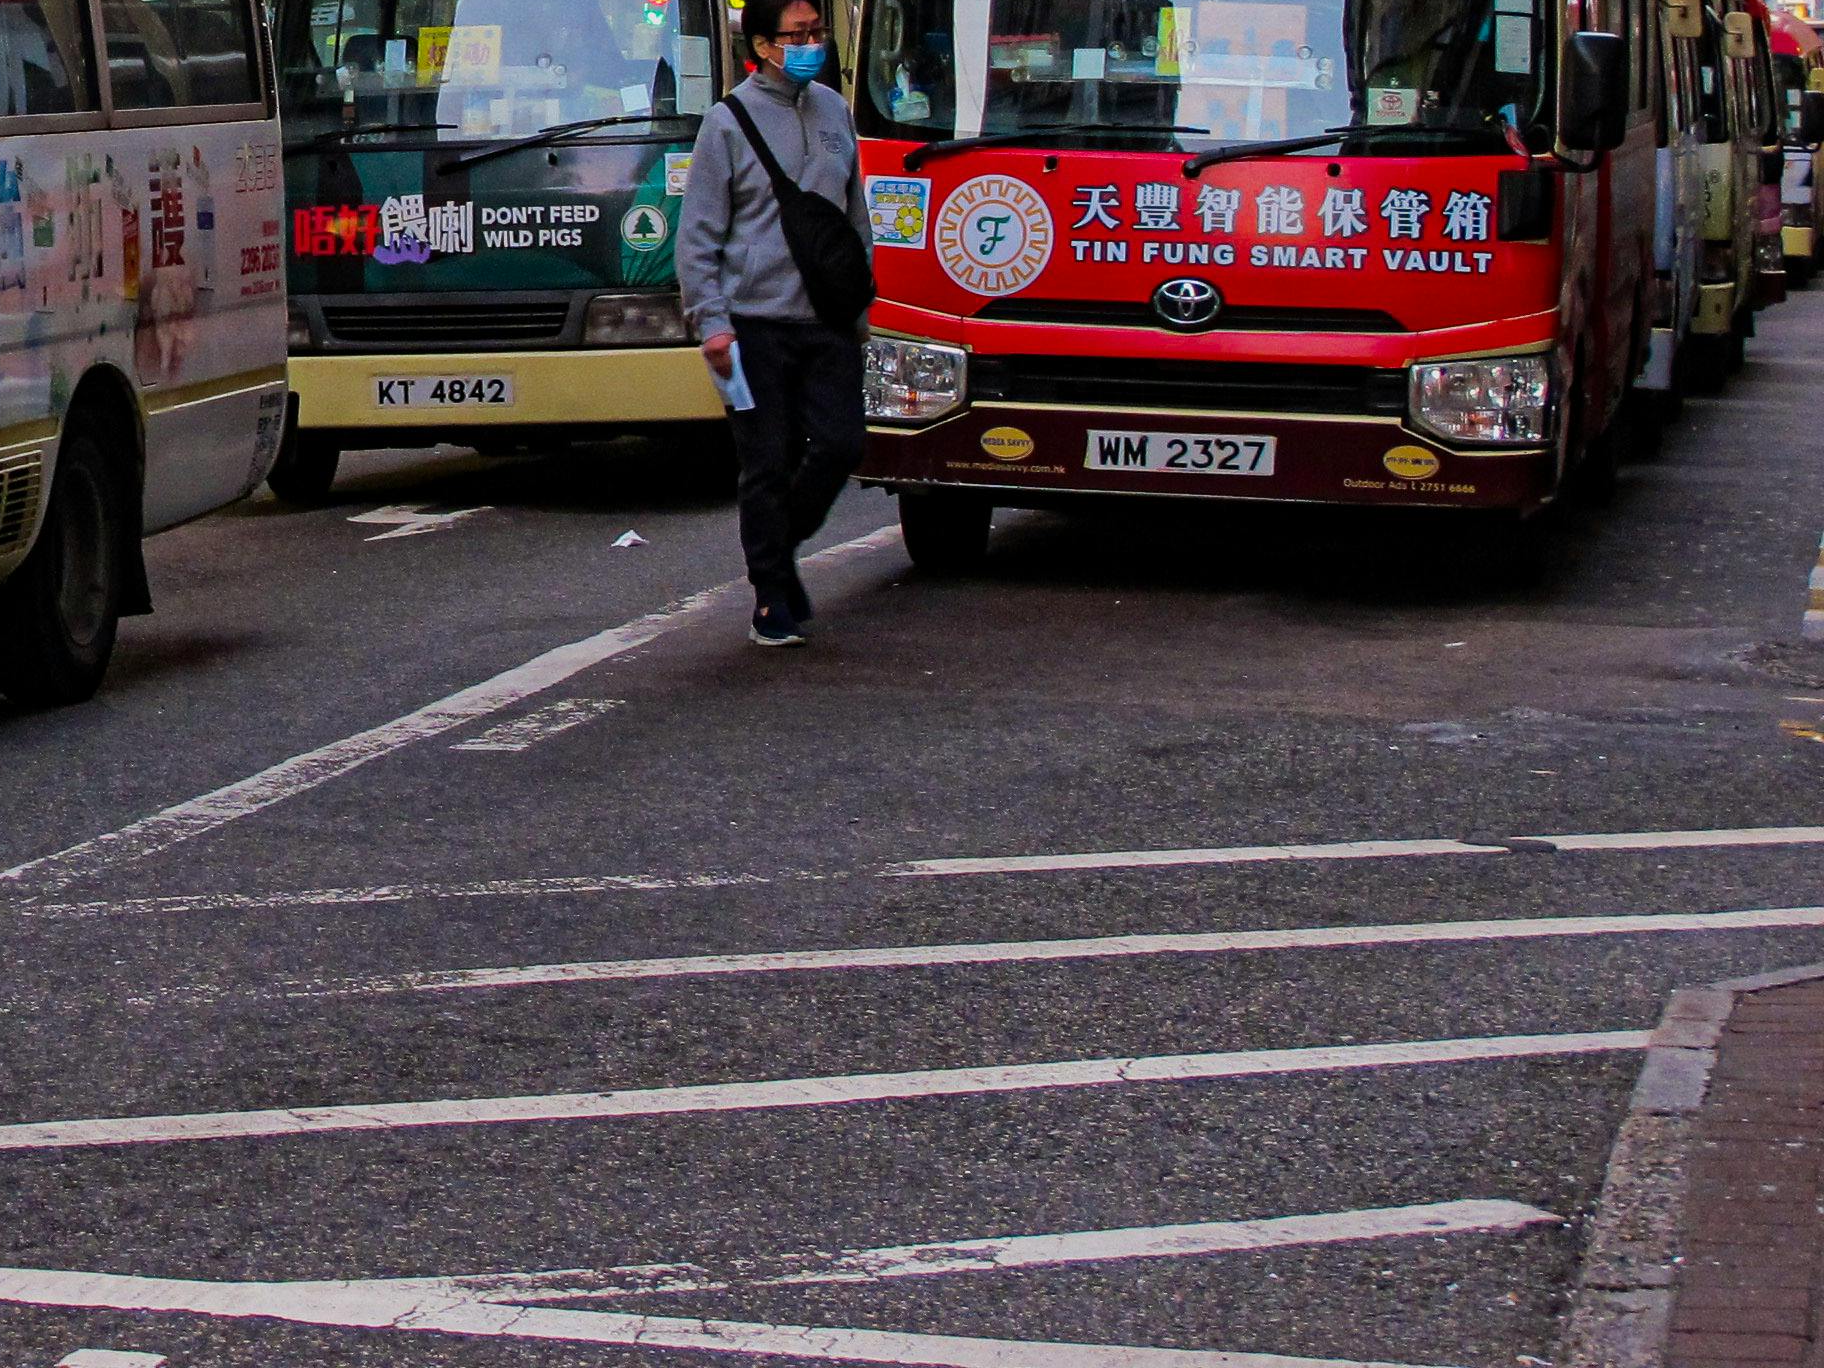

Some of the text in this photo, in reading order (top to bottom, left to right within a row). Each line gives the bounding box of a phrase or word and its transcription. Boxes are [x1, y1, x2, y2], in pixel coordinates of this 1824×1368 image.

[481, 204, 600, 225] DON'T FEED
[1071, 181, 1494, 243] 天豐智能保管箱
[482, 228, 583, 248] WILD PIGS
[1070, 240, 1494, 275] TIN FUNG SMART VAULT
[377, 378, 507, 405] KT 4842
[1098, 435, 1267, 473] WM 2327
